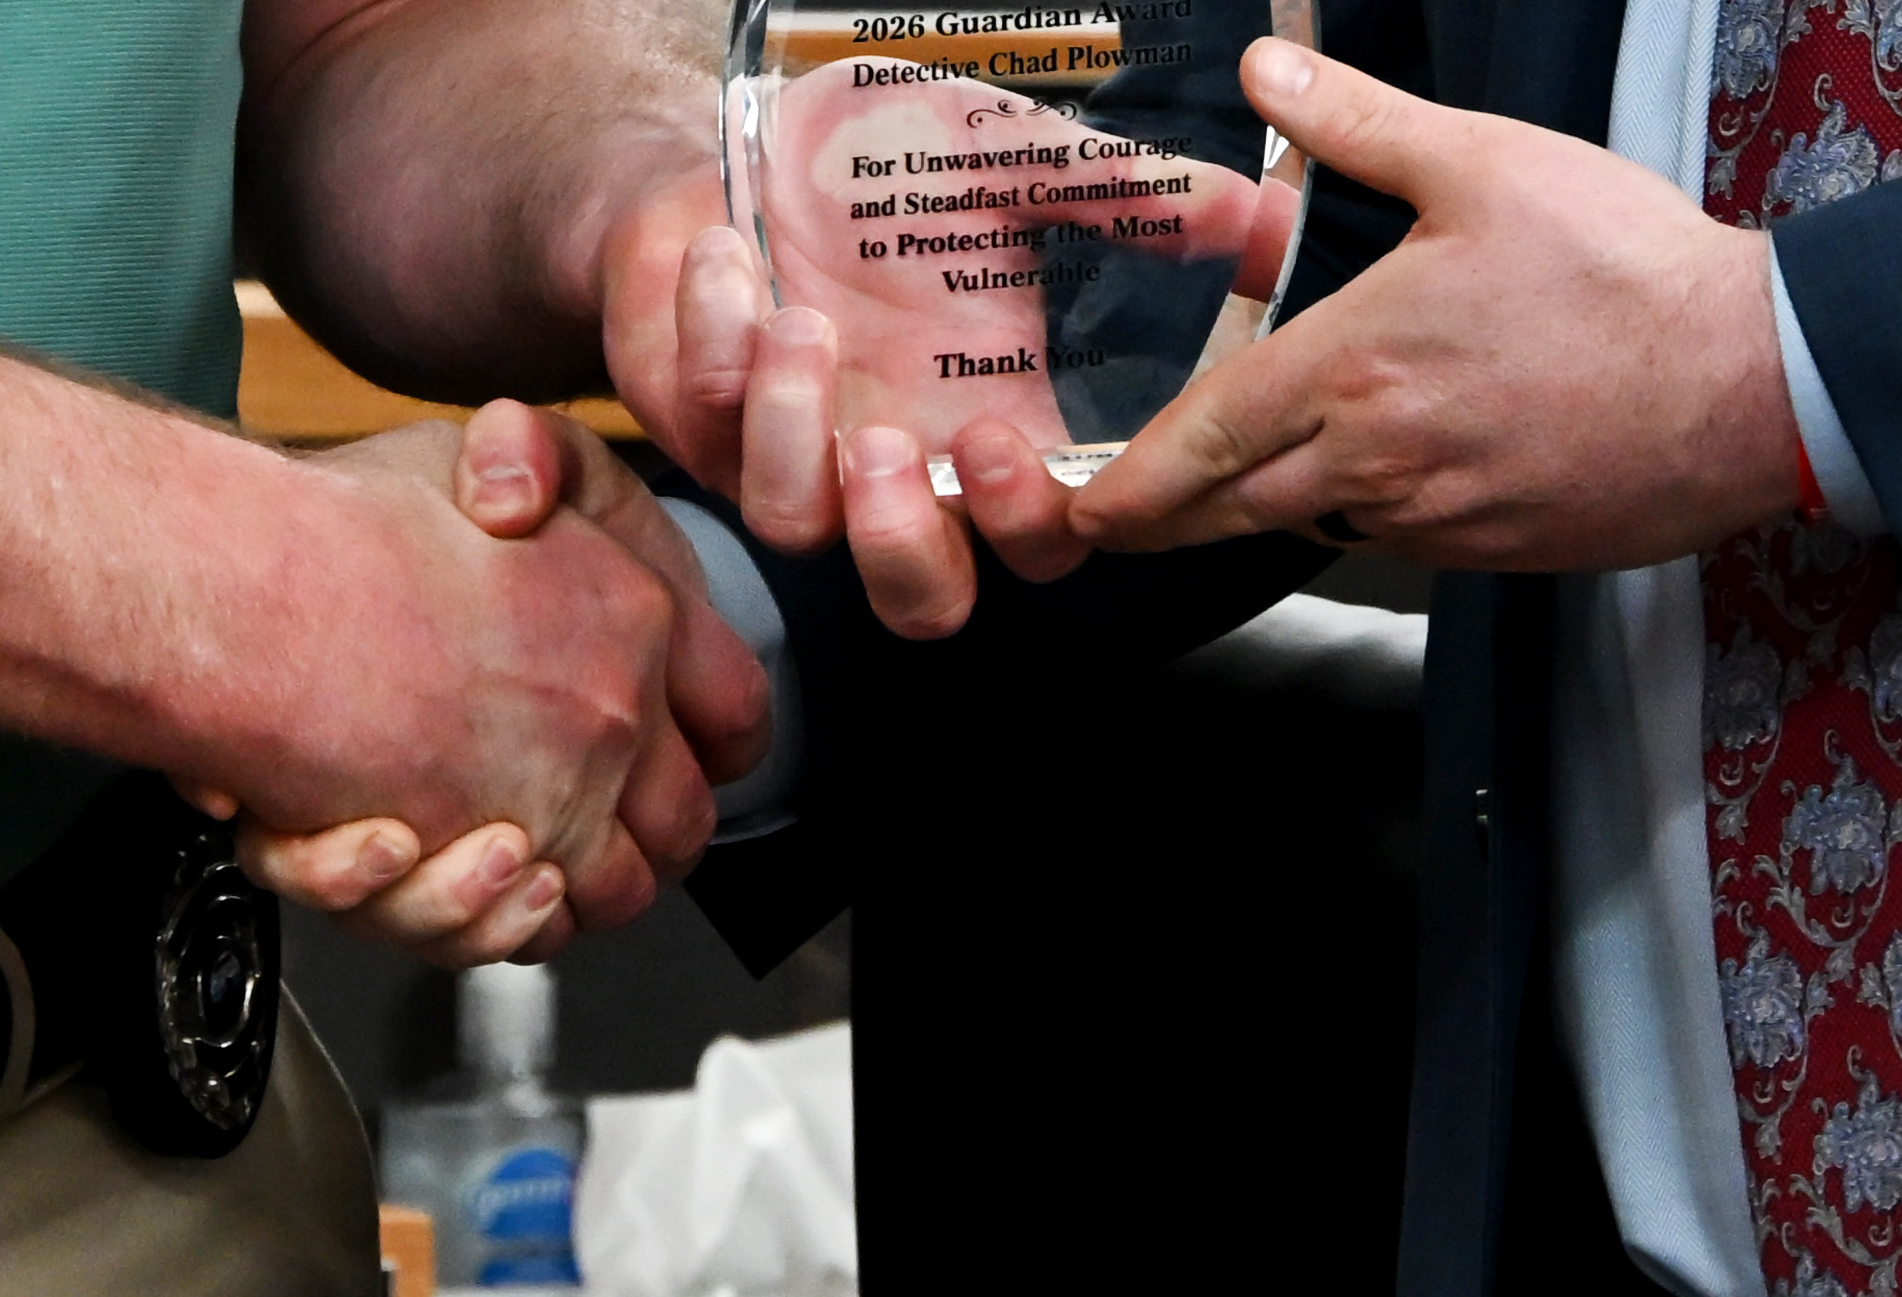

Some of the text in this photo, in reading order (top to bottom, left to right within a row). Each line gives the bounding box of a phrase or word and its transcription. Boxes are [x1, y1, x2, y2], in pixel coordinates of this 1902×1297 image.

[852, 14, 925, 43] 2026
[935, 5, 1082, 36] Guardian
[853, 43, 1192, 88] Detective Chad Plowman
[851, 135, 1192, 179] For Unwavering Courage
[850, 172, 1192, 219] and Steadfast Commitment
[859, 214, 1184, 259] to Protecting the Most
[942, 261, 1100, 293] Vulnerable
[934, 346, 1105, 379] Thank You
